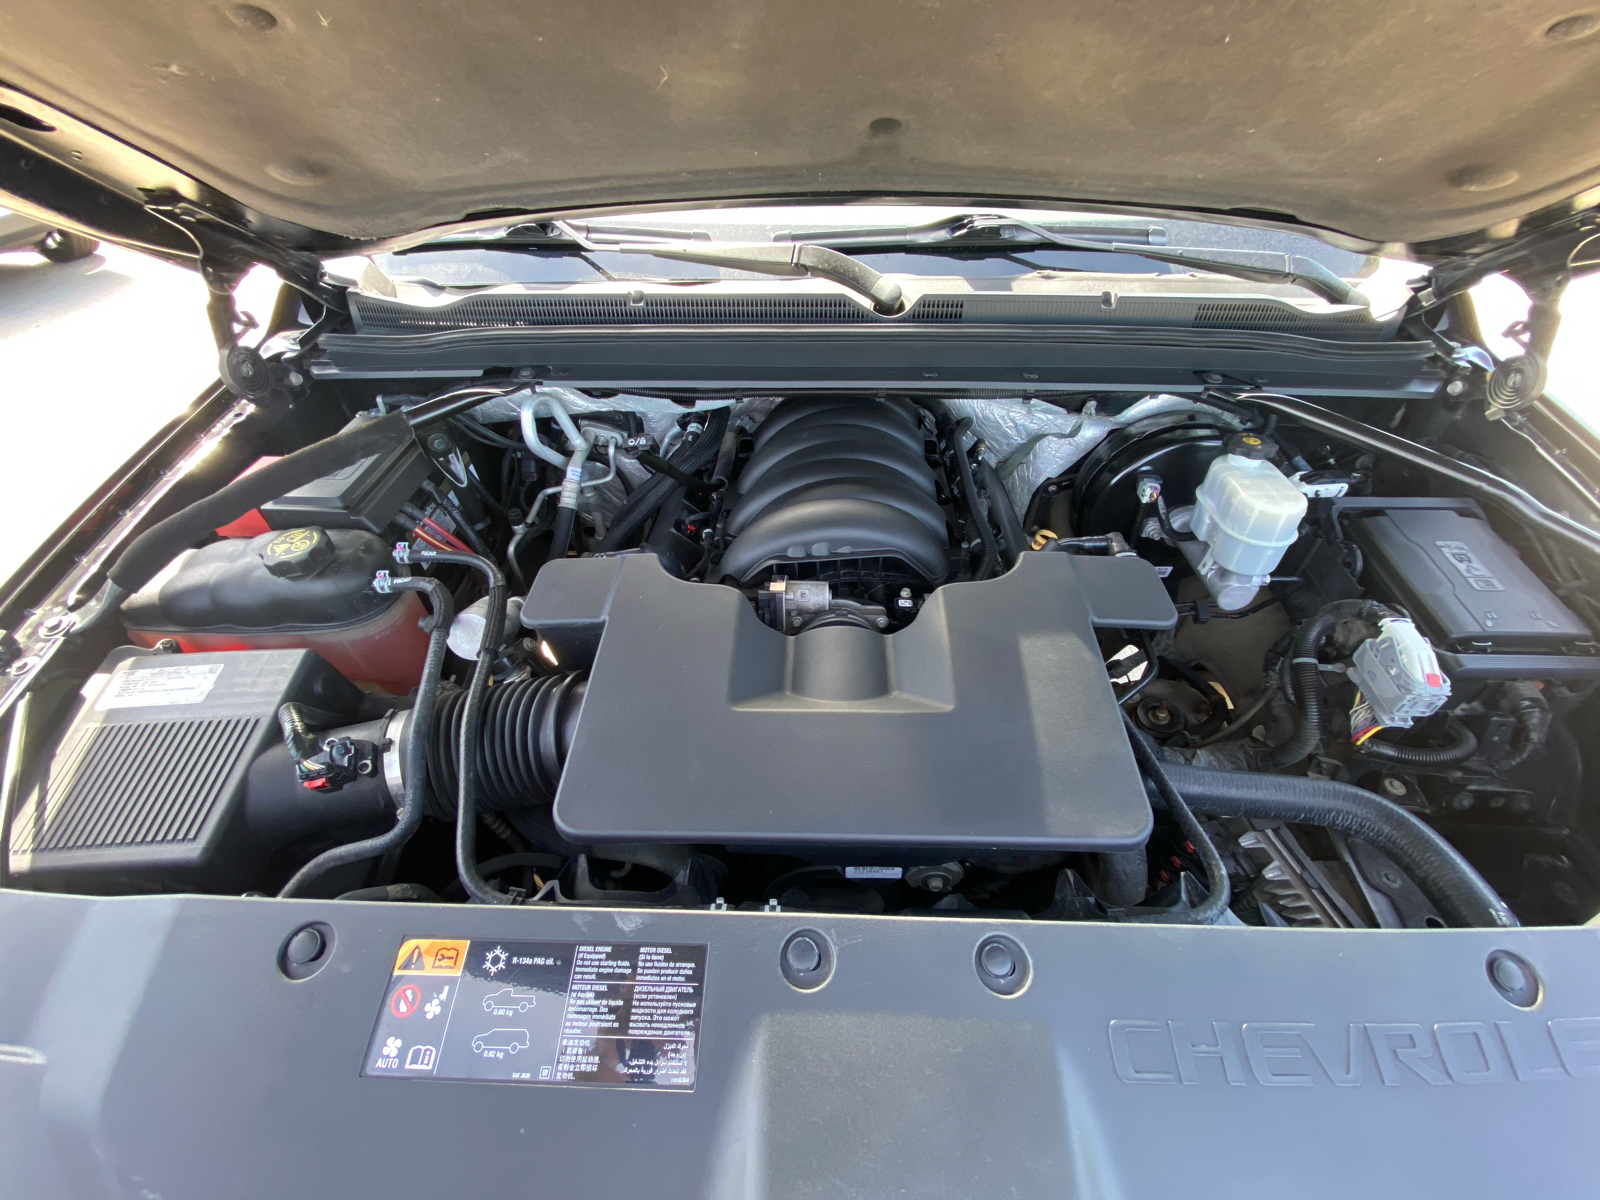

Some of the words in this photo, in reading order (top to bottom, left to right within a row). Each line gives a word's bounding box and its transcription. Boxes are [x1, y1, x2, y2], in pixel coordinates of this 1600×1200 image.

[512, 956, 532, 965] R-134a
[533, 957, 545, 965] PAG
[506, 1009, 514, 1017] kg
[496, 1051, 504, 1059] kg
[1108, 1017, 1600, 1087] CHEVROLE
[375, 1058, 398, 1068] AUTO
